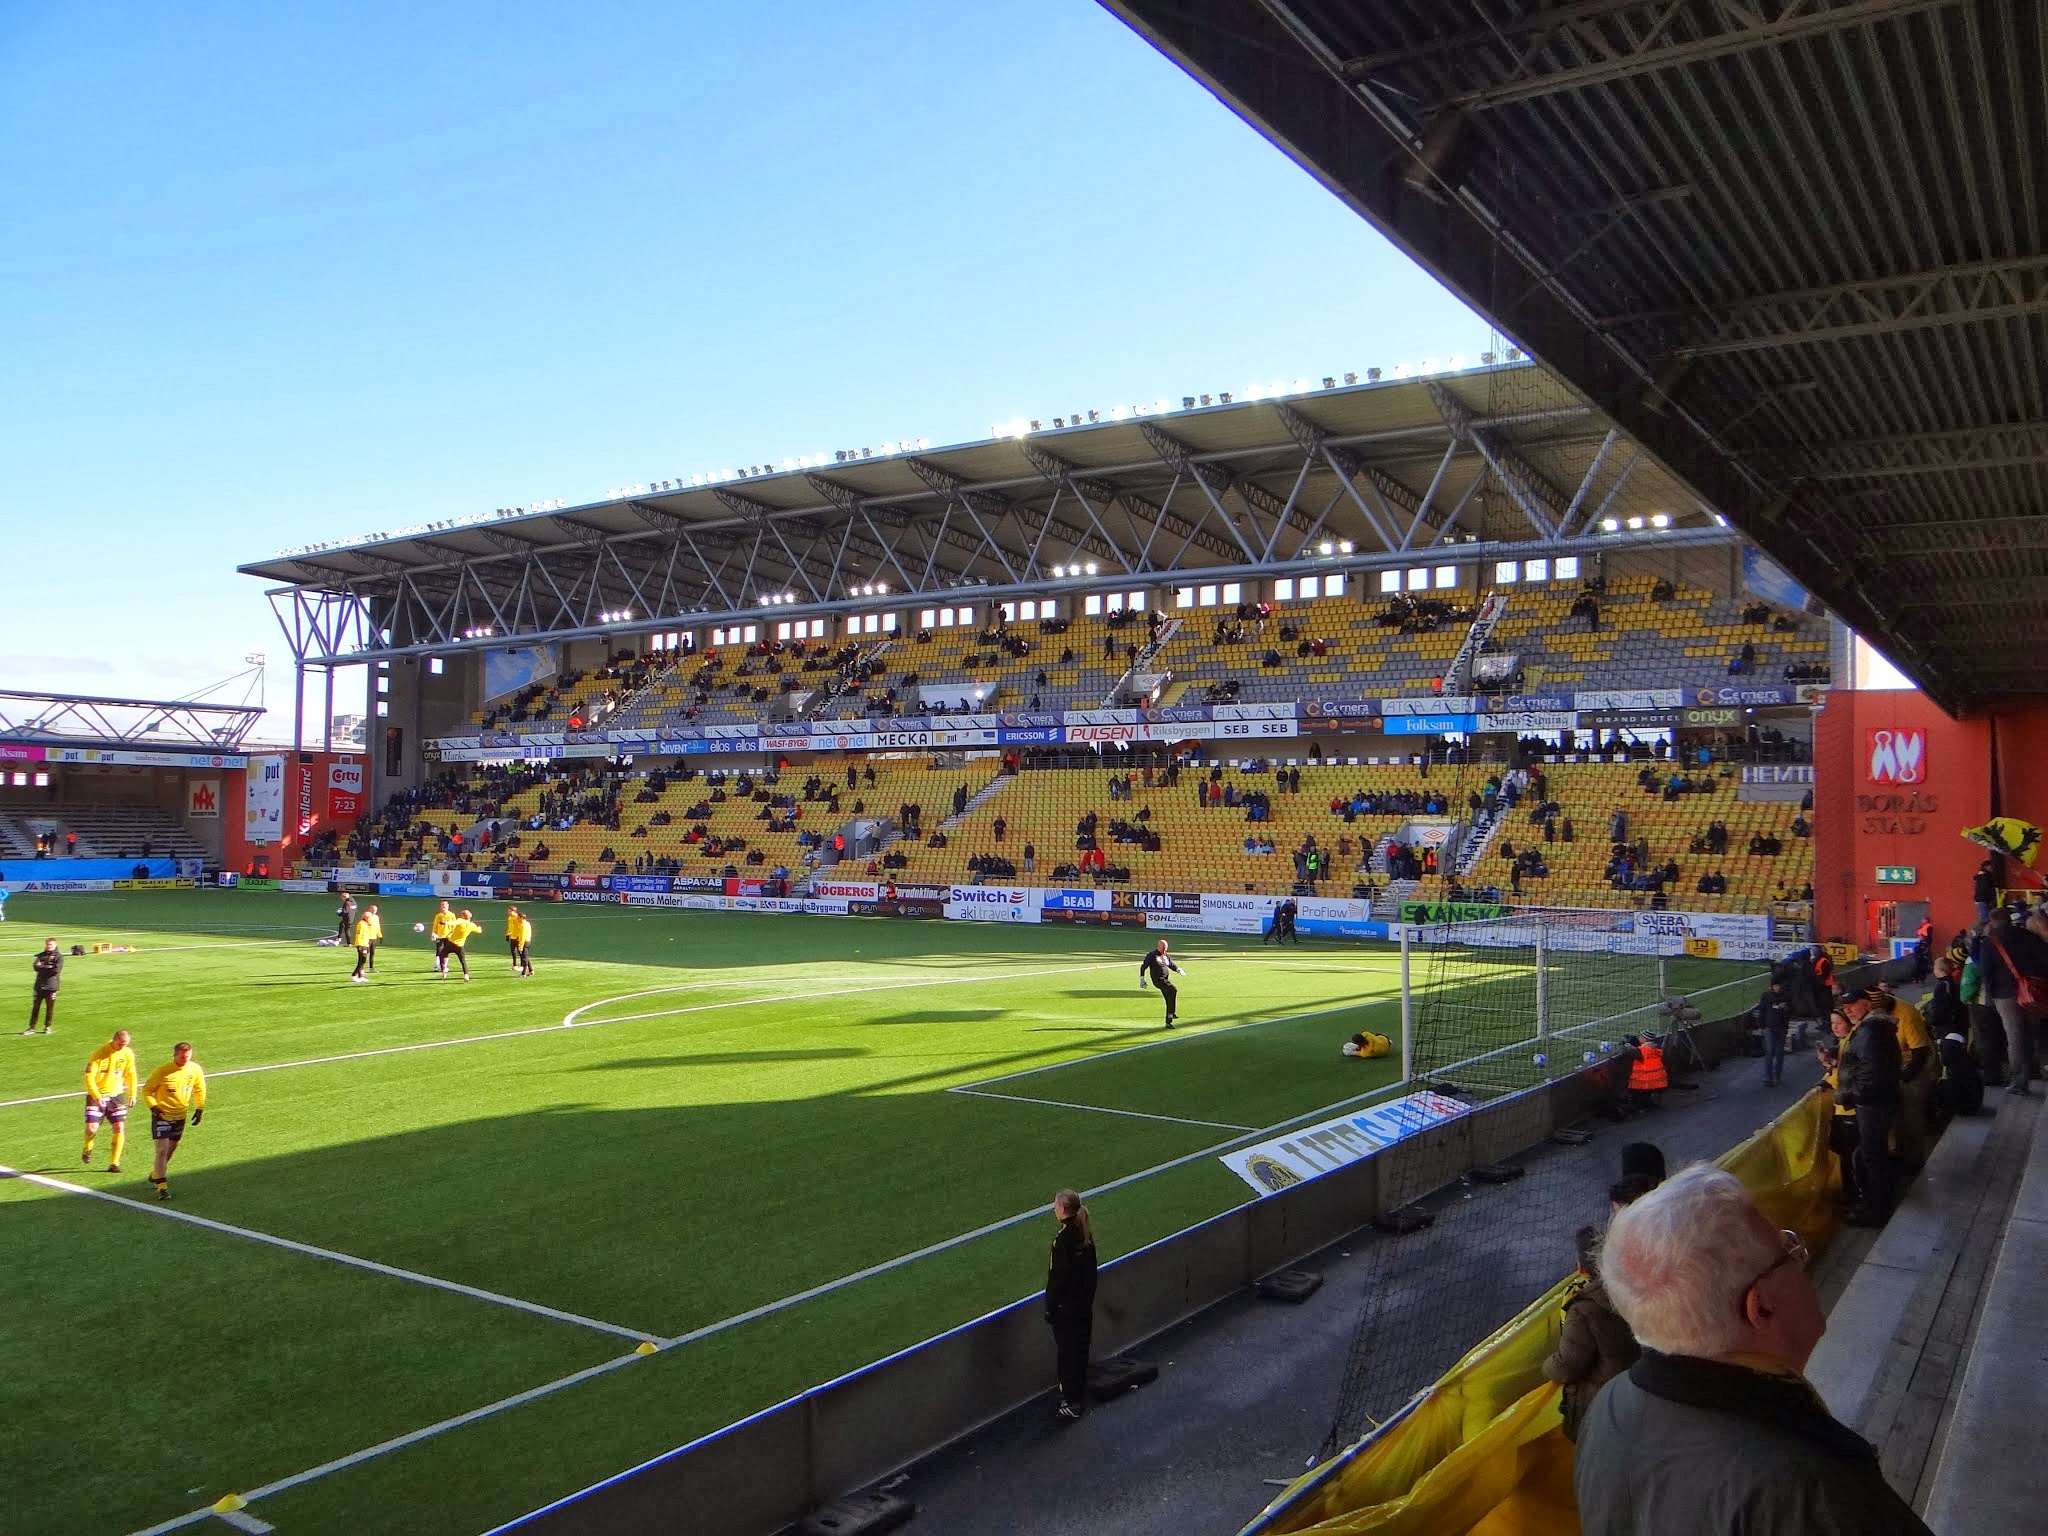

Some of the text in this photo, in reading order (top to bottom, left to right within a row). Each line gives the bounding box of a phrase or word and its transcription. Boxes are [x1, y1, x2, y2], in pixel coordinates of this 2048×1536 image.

[1688, 710, 1736, 725] onyx
[1224, 724, 1288, 734] SEB SEB
[1406, 720, 1453, 731] Folksam
[1006, 731, 1045, 741] ERICSSON
[1070, 727, 1134, 741] PULSEN
[1153, 725, 1210, 739] Riksbyggen
[766, 739, 808, 748] WAST-BYGG
[818, 738, 837, 748] net
[849, 736, 867, 747] net
[878, 734, 927, 746] MECKA
[947, 733, 957, 744] put
[710, 742, 756, 753] ellos ellos
[65, 751, 78, 761] put
[102, 752, 114, 762] put
[190, 755, 210, 766] net
[224, 756, 243, 767] net
[266, 762, 280, 783] put
[1743, 766, 1814, 783] HEMT
[300, 768, 312, 837] Knalleland
[335, 801, 356, 810] 7-23
[381, 872, 416, 881] INTERSPORT
[673, 878, 722, 887] ASPA AB
[453, 887, 479, 897] stiba
[564, 892, 599, 902] OLOFSSON
[600, 892, 620, 902] BYGG
[952, 889, 1007, 904] Switch
[622, 892, 683, 906] Kimmos Måleri
[1063, 896, 1093, 907] BEAB
[1134, 893, 1172, 909] ikkab
[1202, 899, 1254, 910] SIMONSLAND
[960, 906, 1010, 920] aki travel
[1302, 906, 1347, 918] ProFlow
[1642, 915, 1685, 926] SVEBA
[1649, 926, 1697, 938] DAHLN
